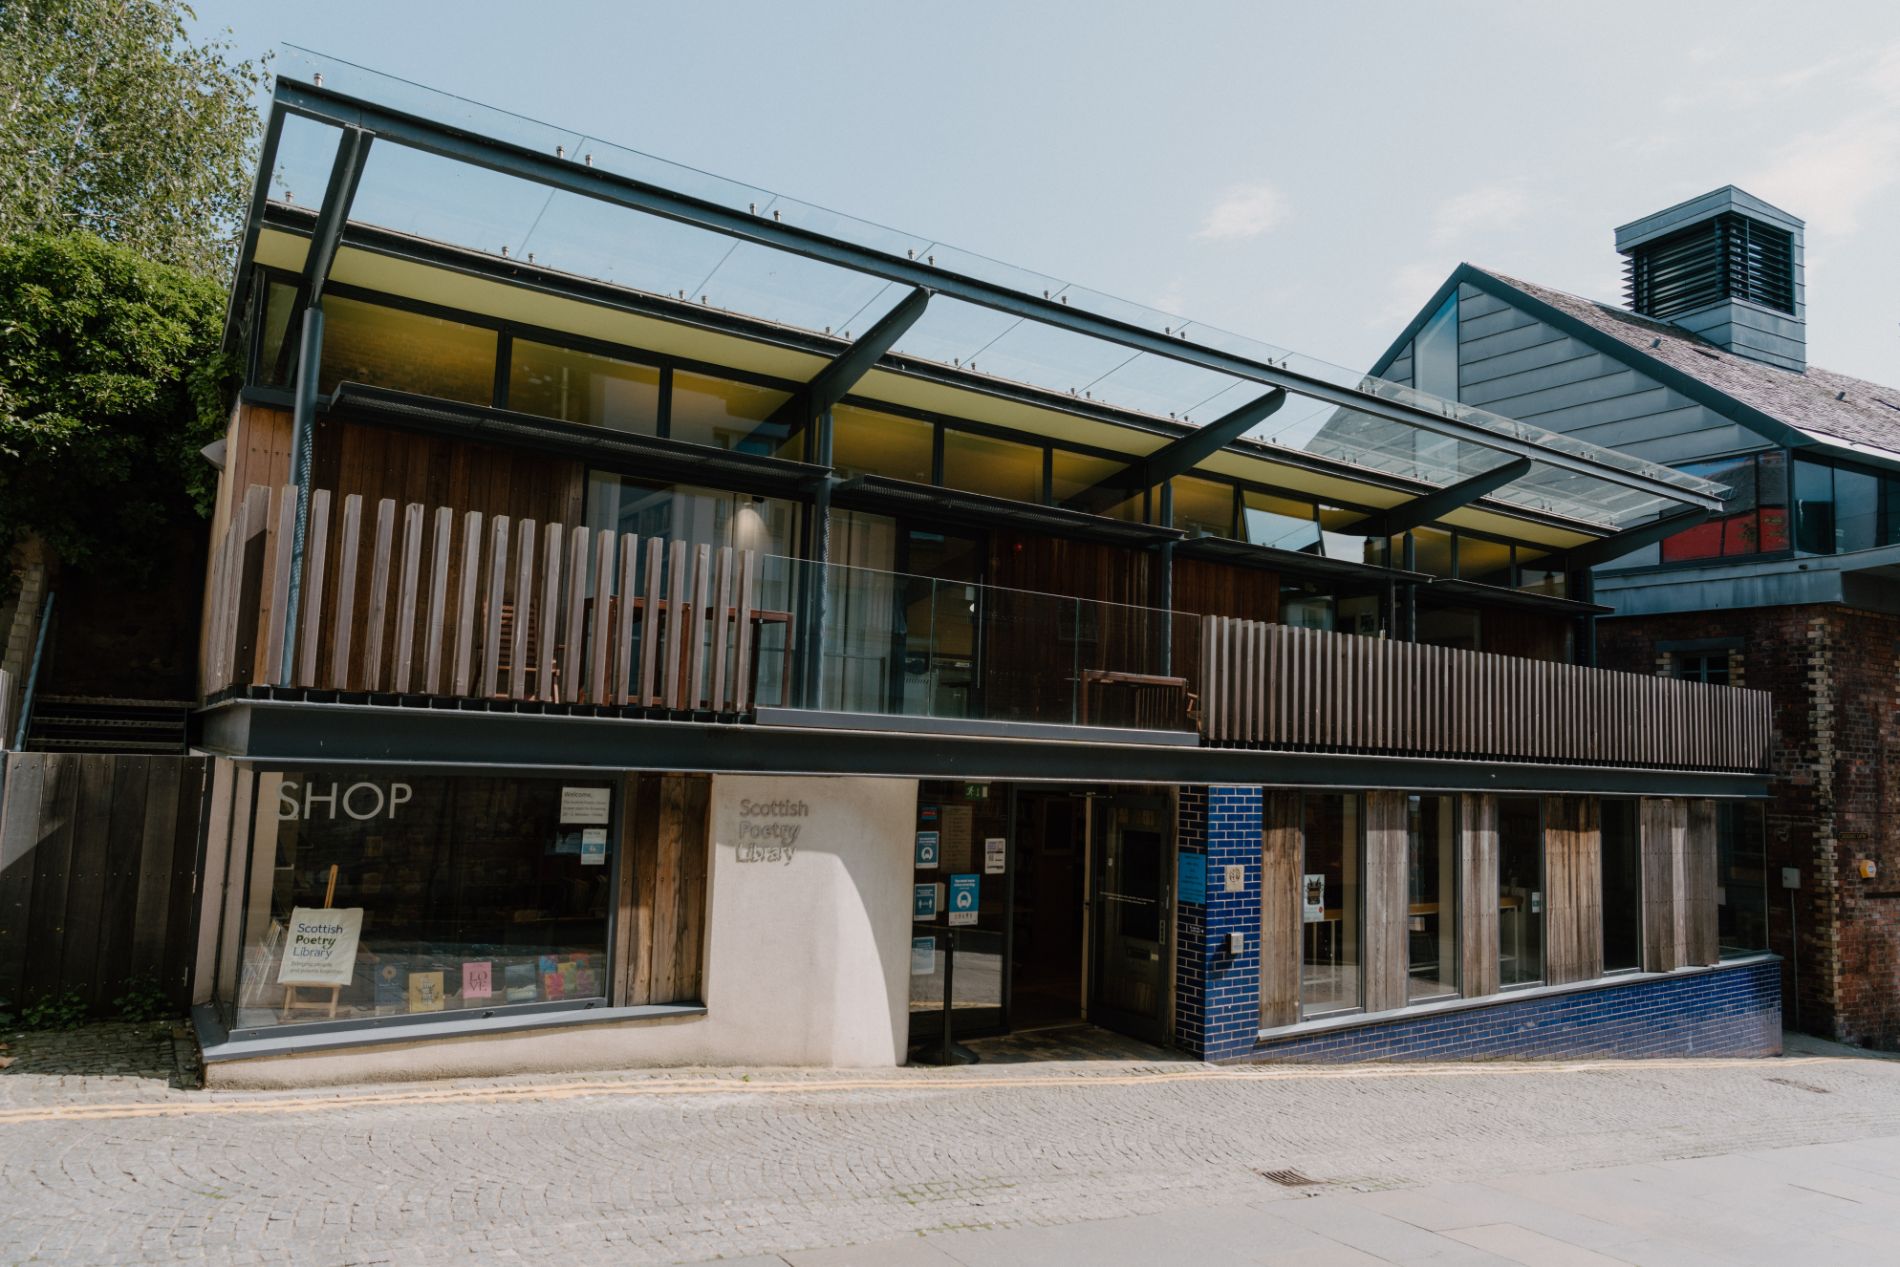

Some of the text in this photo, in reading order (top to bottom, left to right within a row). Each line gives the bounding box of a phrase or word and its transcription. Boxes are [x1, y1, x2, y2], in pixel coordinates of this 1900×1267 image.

[275, 781, 413, 820] SHOP
[739, 798, 809, 817] Scottish
[739, 820, 801, 848] Poetry
[735, 842, 796, 867] Library
[297, 923, 343, 934] Scottish
[295, 934, 337, 950] Poetry
[293, 947, 334, 960] Library
